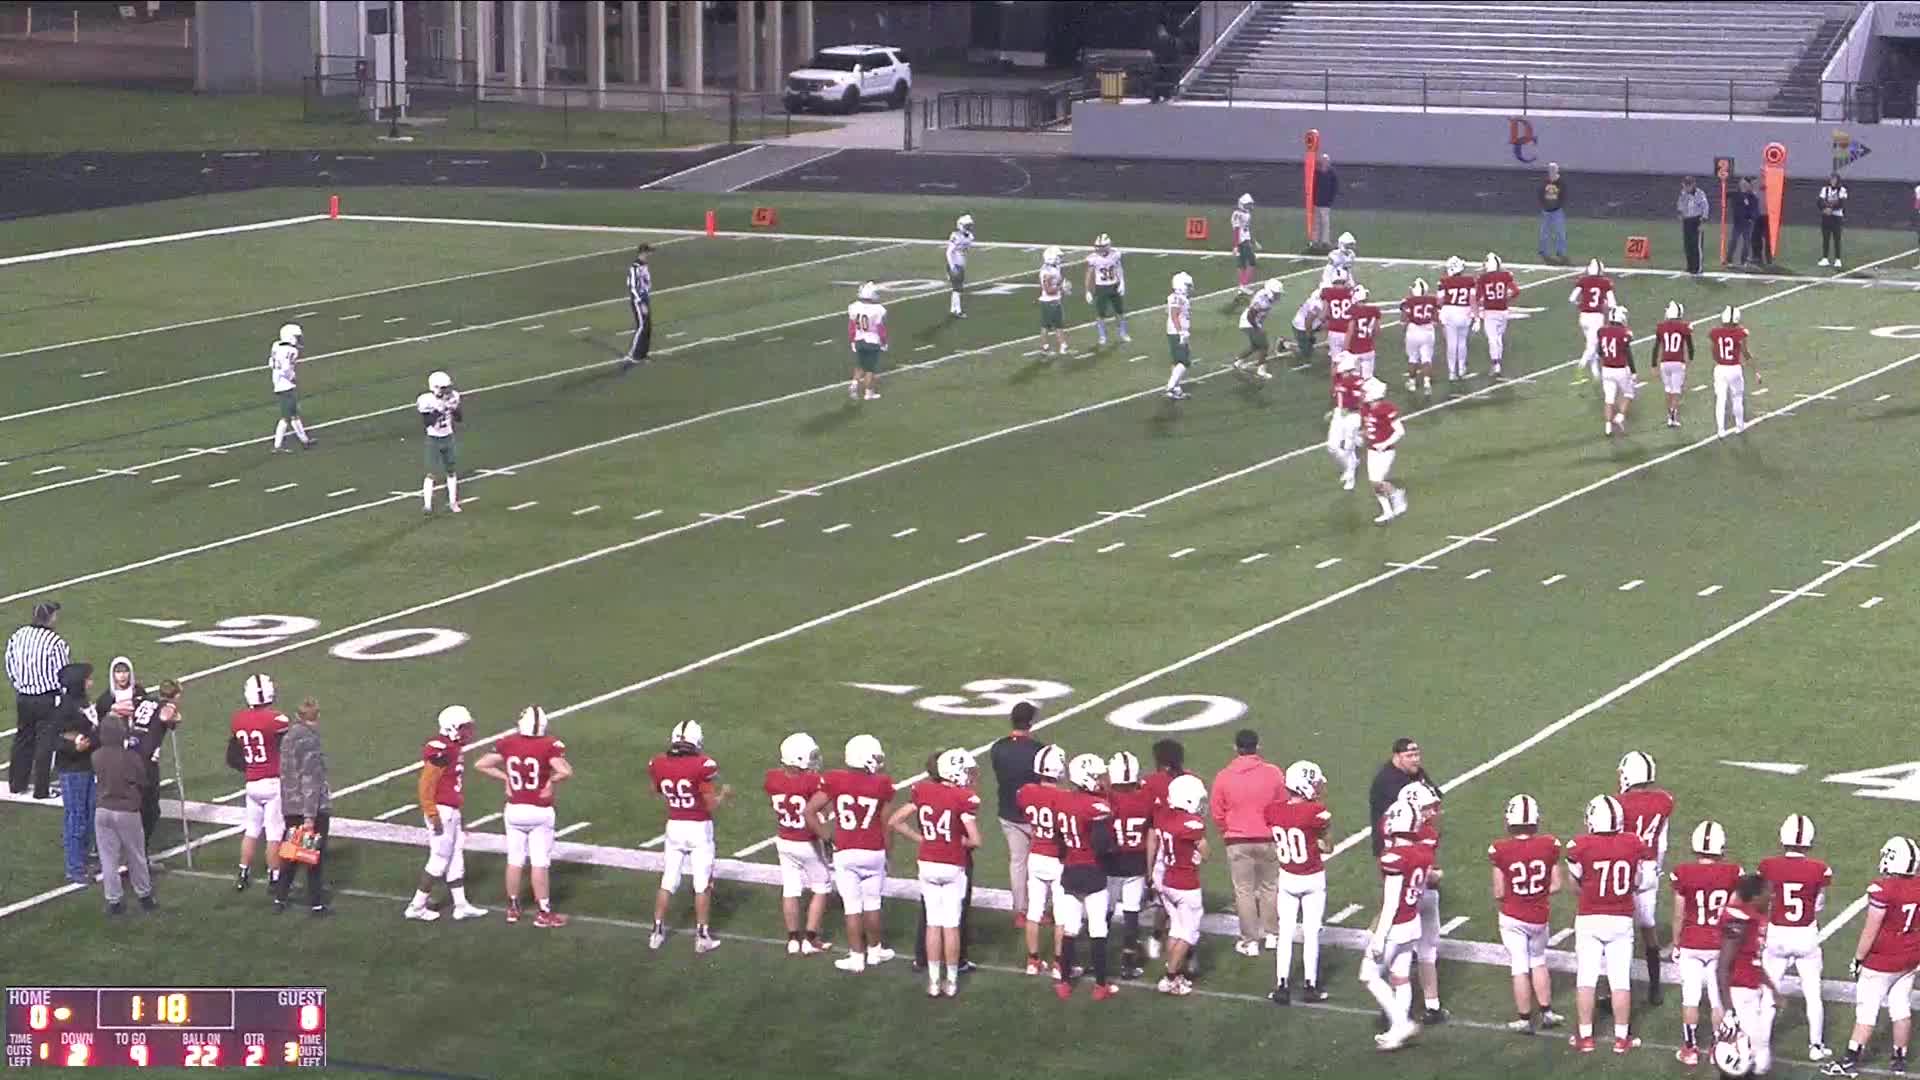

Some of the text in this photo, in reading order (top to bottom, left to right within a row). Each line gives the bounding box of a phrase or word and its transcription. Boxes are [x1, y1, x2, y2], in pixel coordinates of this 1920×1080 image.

[1188, 219, 1206, 234] 10
[1627, 239, 1645, 253] 20
[1448, 288, 1469, 304] 72
[1485, 282, 1505, 300] 58
[1589, 287, 1600, 308] 3
[1358, 317, 1376, 338] 54
[1664, 332, 1682, 352] 10
[1718, 337, 1734, 360] 12
[158, 614, 470, 661] 20
[914, 678, 1249, 731] 30
[236, 730, 268, 763] 33
[506, 756, 540, 790] 63
[661, 779, 695, 808] 66
[771, 794, 806, 828] 53
[836, 794, 879, 830] 67
[919, 805, 952, 842] 64
[1113, 817, 1146, 847] 15
[1271, 826, 1308, 864] 80
[1636, 813, 1663, 848] 14
[1509, 859, 1547, 895] 22
[1593, 860, 1632, 897] 70
[1695, 889, 1728, 926] 19
[1783, 882, 1804, 922] 5
